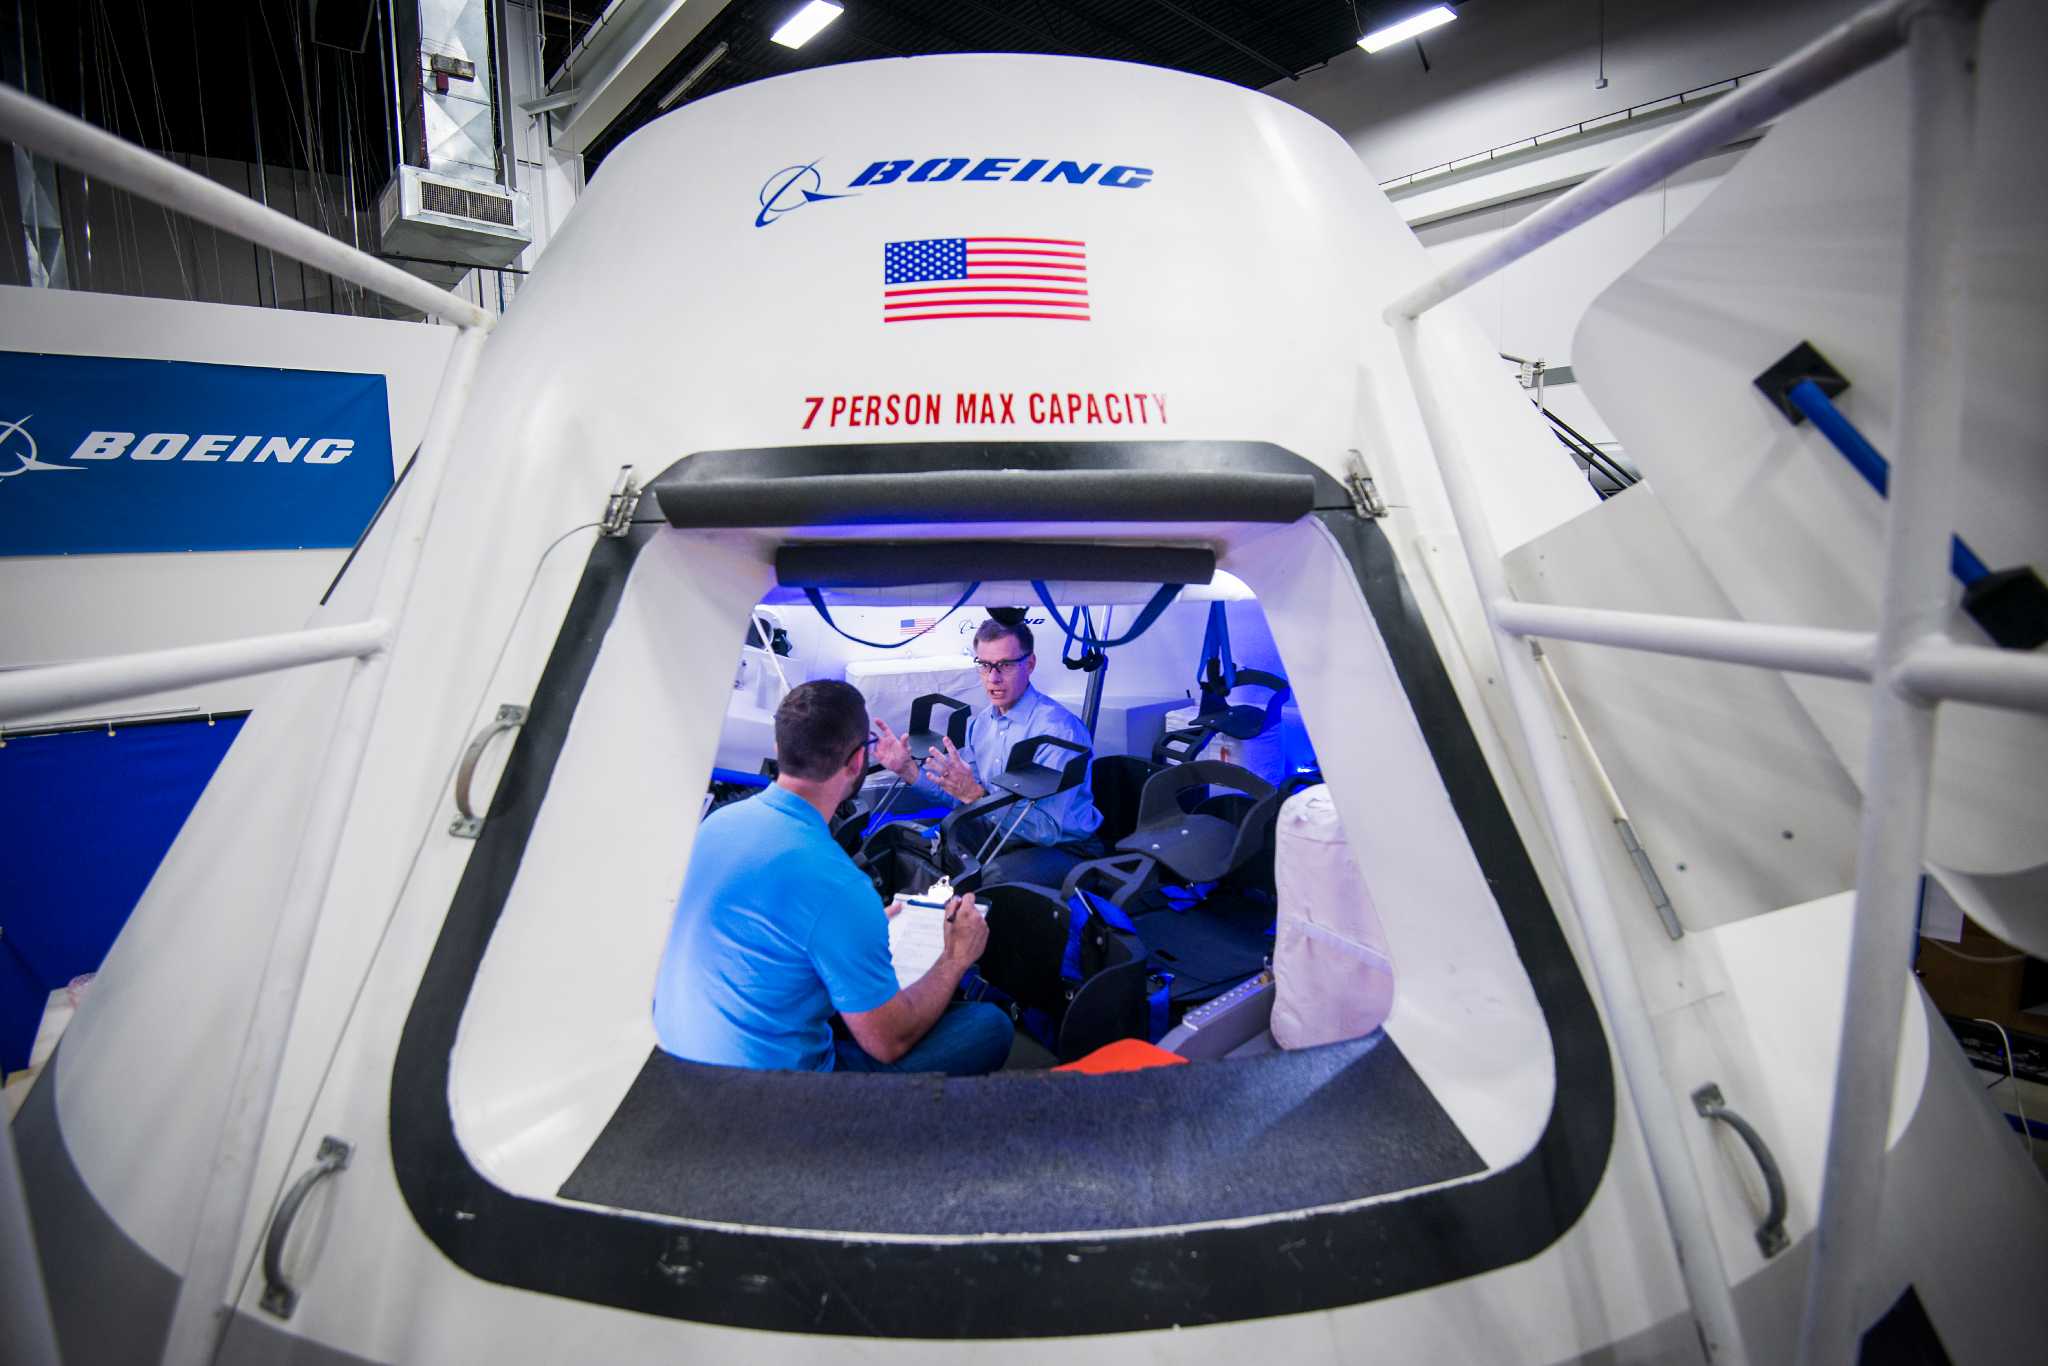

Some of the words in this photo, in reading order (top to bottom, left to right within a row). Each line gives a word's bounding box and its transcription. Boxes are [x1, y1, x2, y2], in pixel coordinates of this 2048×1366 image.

[848, 156, 1154, 189] BOEING
[801, 395, 826, 430] 7
[829, 391, 943, 428] PERSON
[955, 390, 1016, 426] MAX
[1026, 390, 1169, 426] CAPACITY
[70, 431, 355, 465] BOEING
